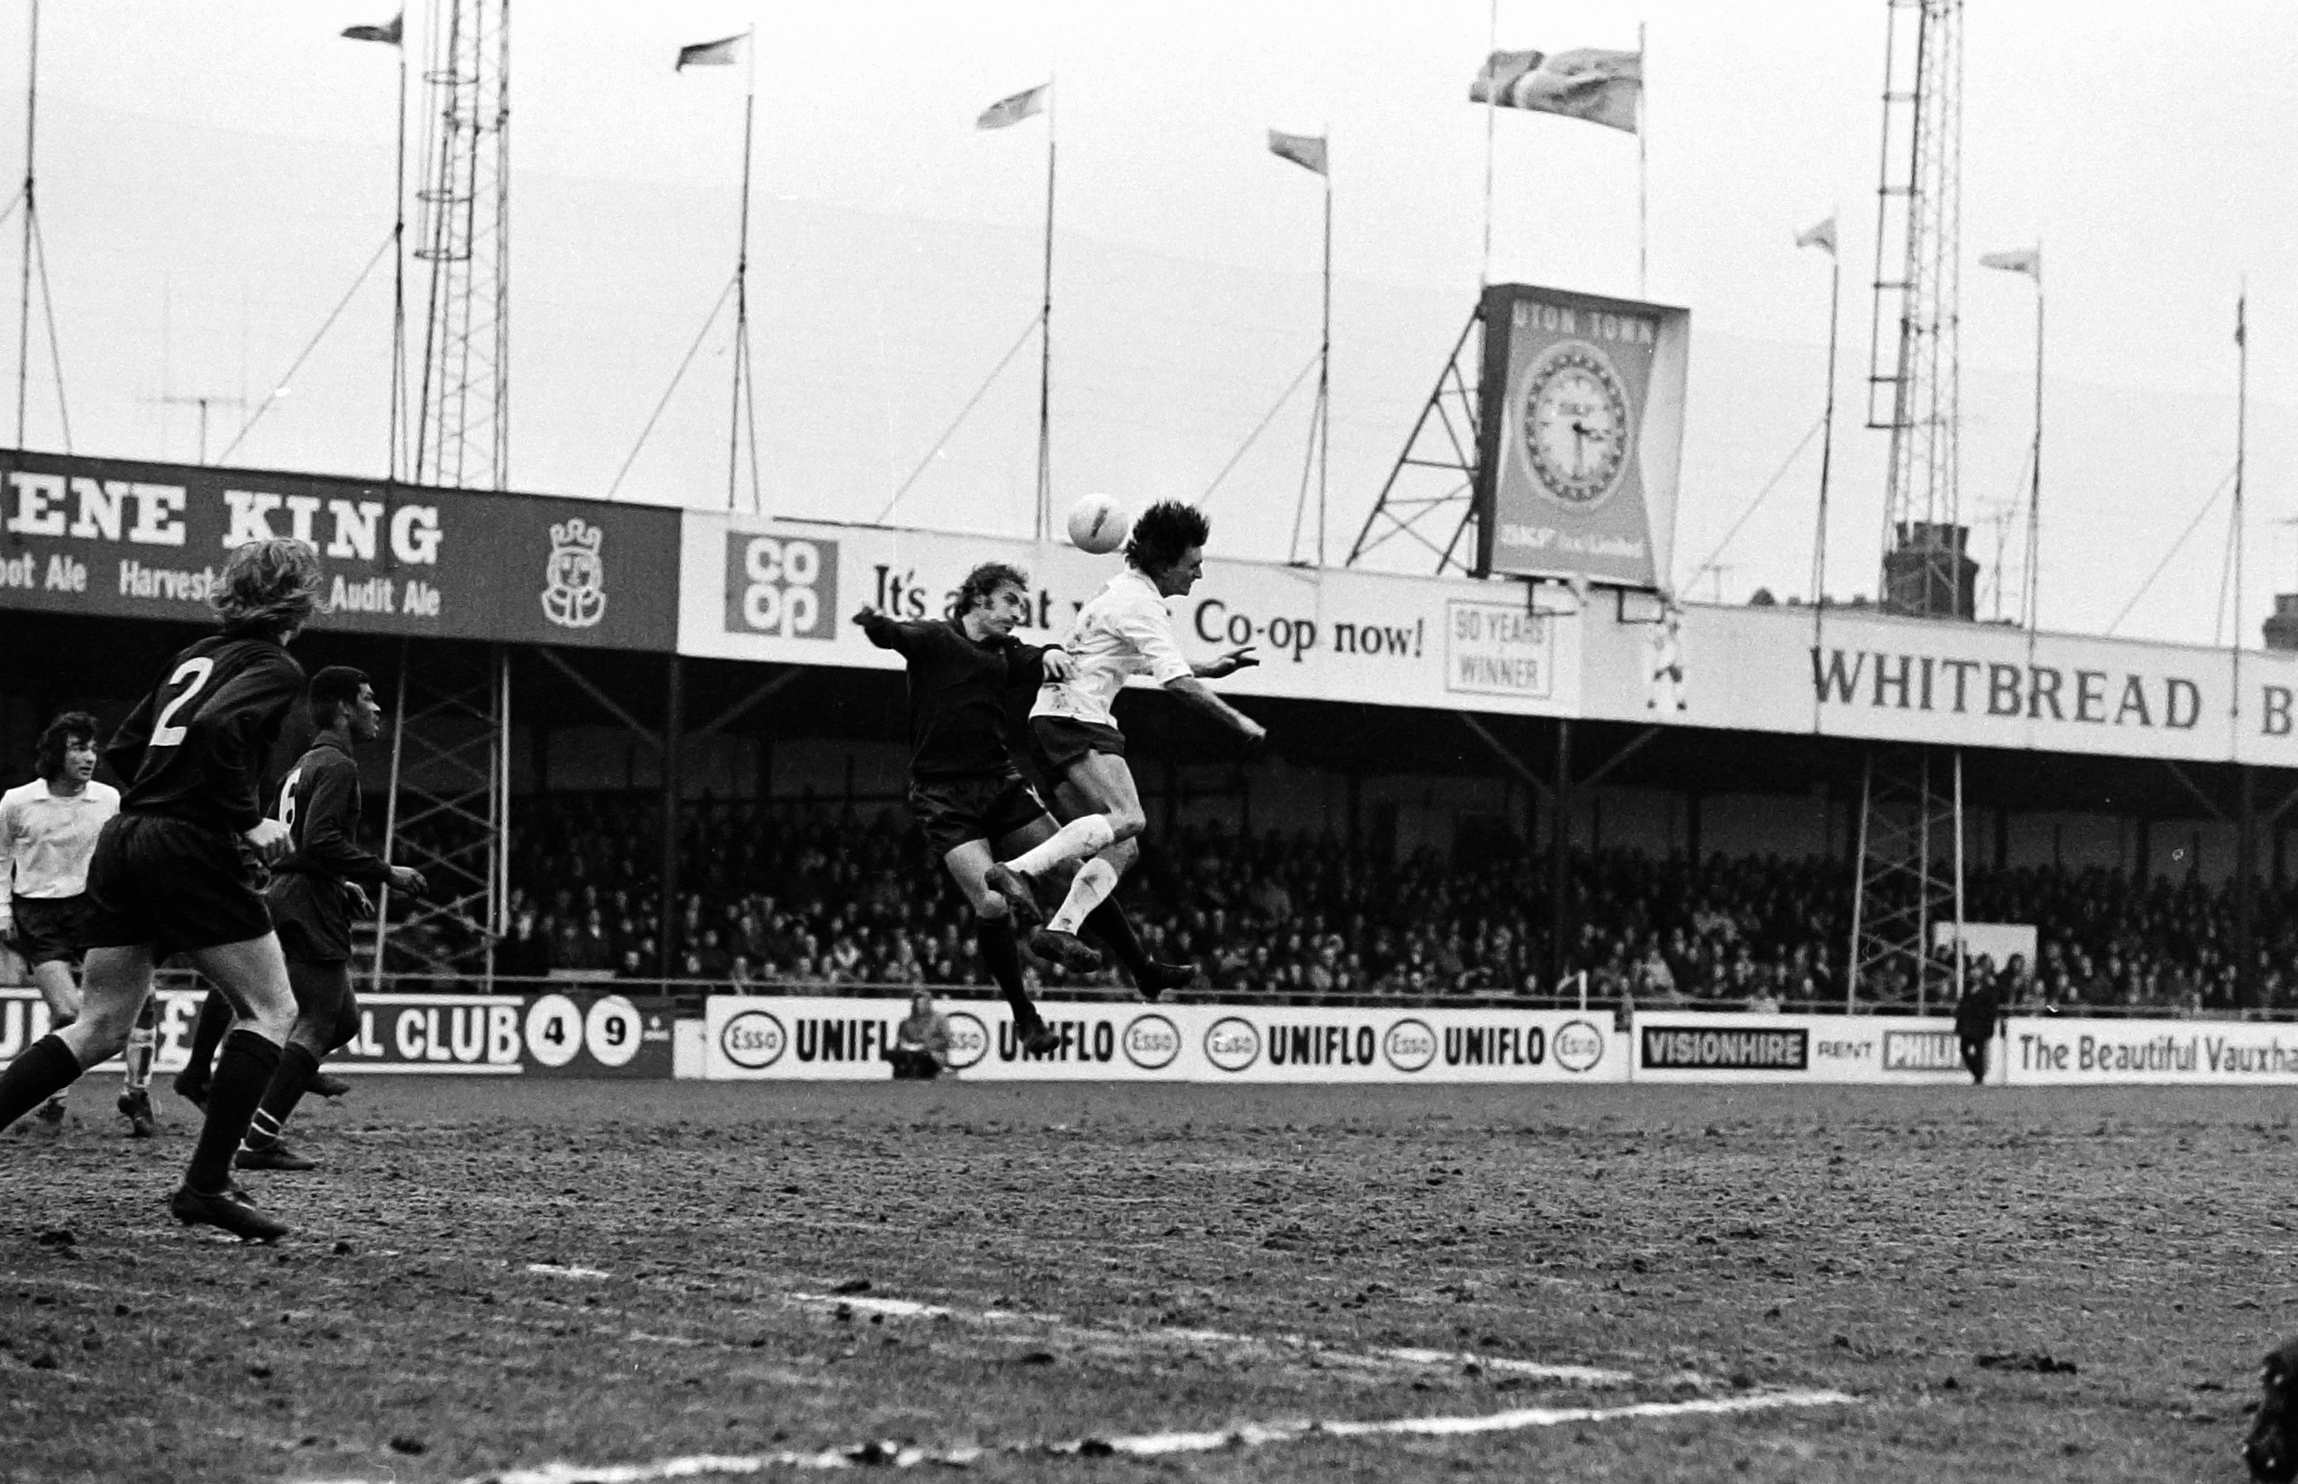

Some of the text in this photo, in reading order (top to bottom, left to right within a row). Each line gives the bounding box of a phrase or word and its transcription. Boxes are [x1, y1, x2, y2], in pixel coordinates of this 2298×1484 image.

[222, 489, 443, 564] KING
[44, 553, 87, 592] Ale
[330, 574, 395, 614] Audit
[403, 580, 441, 616] Ale
[873, 565, 926, 620] It's
[1194, 597, 1318, 663] Co-op
[1334, 617, 1424, 658] now!
[1458, 653, 1539, 689] WINNER
[1811, 646, 2202, 730] WHITBREAD
[149, 656, 214, 747] 2
[397, 1005, 522, 1064] CLUB
[797, 1018, 898, 1063] UNIFL
[1268, 1025, 1377, 1066] UNIFLO
[1445, 1026, 1546, 1067] UNIFLO
[1648, 1030, 1803, 1066] VISIONHIRE
[2020, 1034, 2069, 1071] The
[2079, 1035, 2198, 1072] Beautiful
